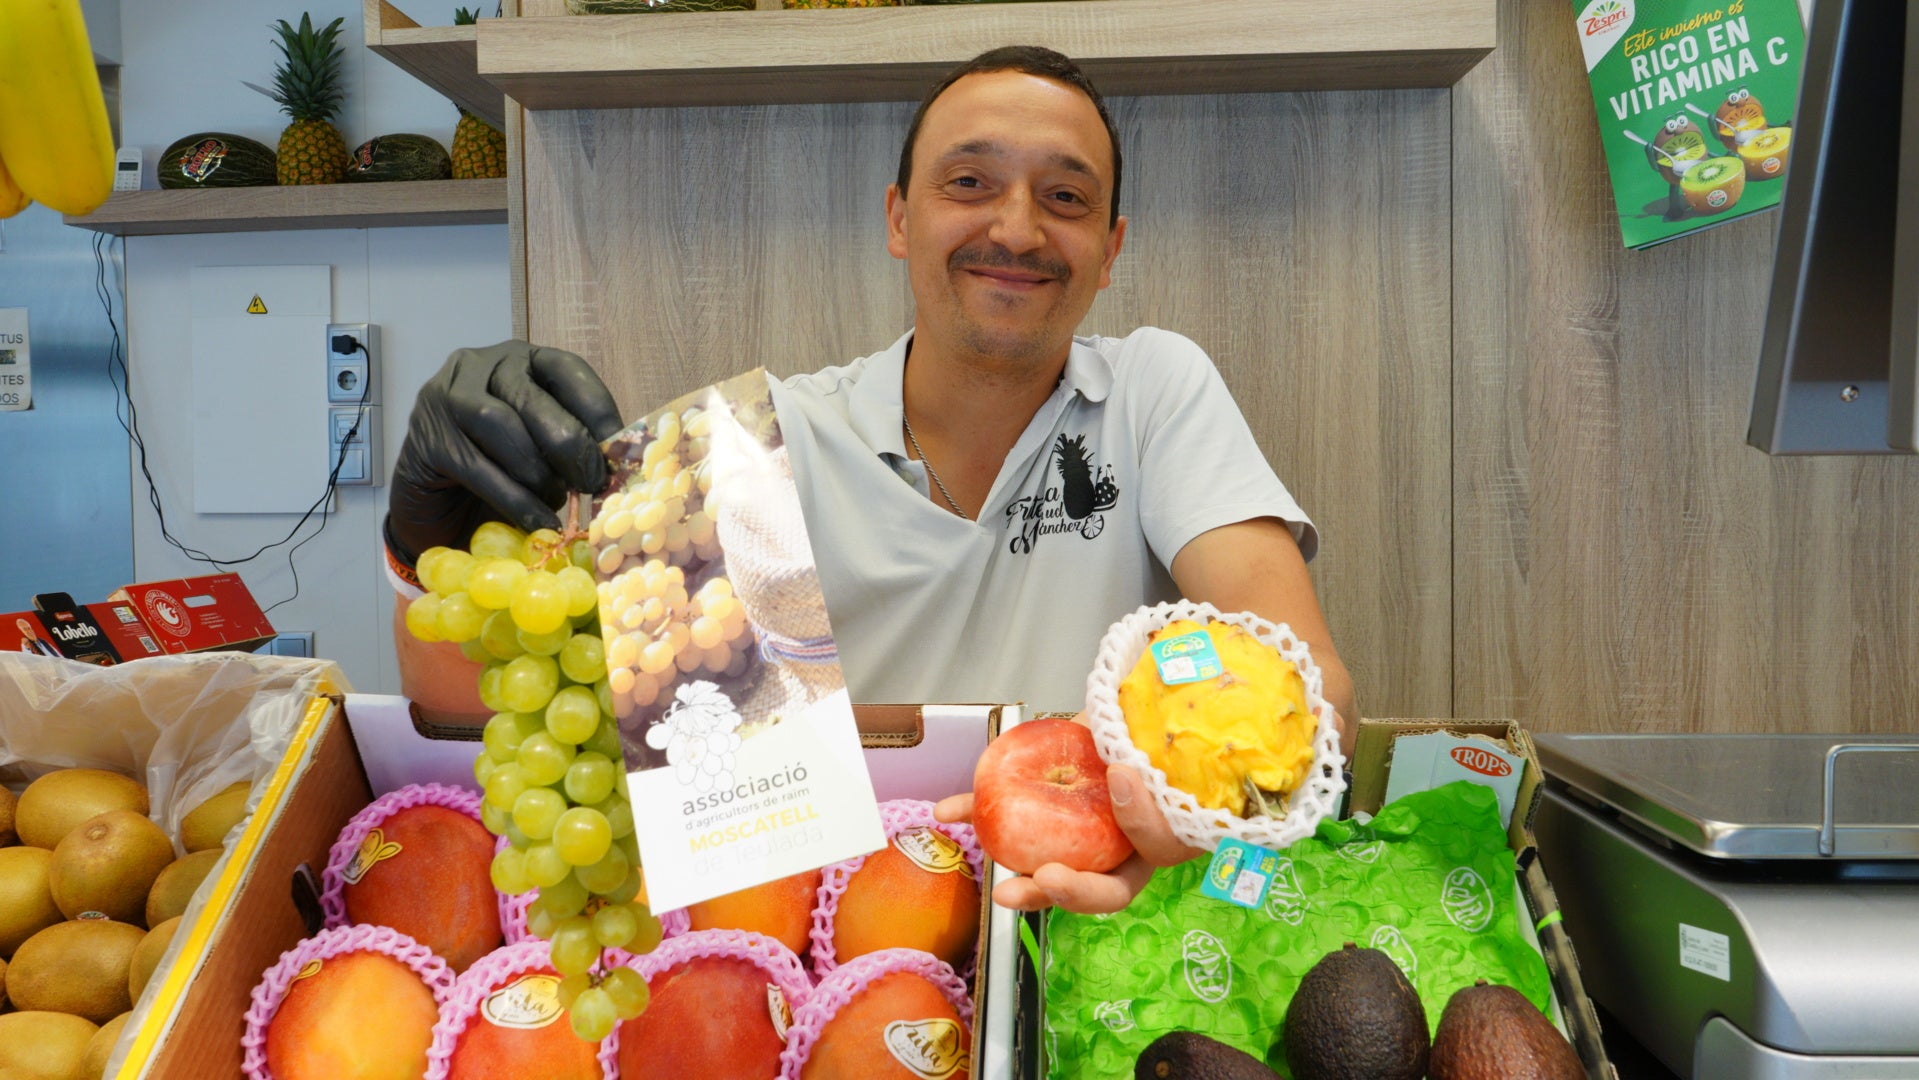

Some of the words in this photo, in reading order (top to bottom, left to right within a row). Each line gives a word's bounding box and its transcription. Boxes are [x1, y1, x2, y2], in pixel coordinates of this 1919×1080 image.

[1583, 7, 1627, 36] Zespri
[1624, 29, 1656, 57] Este
[1660, 11, 1723, 41] invierno
[1631, 35, 1699, 83] RICO
[1707, 16, 1750, 54] EN
[1609, 48, 1759, 121] VITAMINA
[1767, 36, 1788, 66] C
[52, 622, 98, 641] Lobello
[1454, 749, 1509, 776] TROPS
[682, 762, 808, 816] associació
[763, 796, 778, 808] de
[689, 803, 820, 854] MOSCATELL
[906, 1028, 941, 1068] zita
